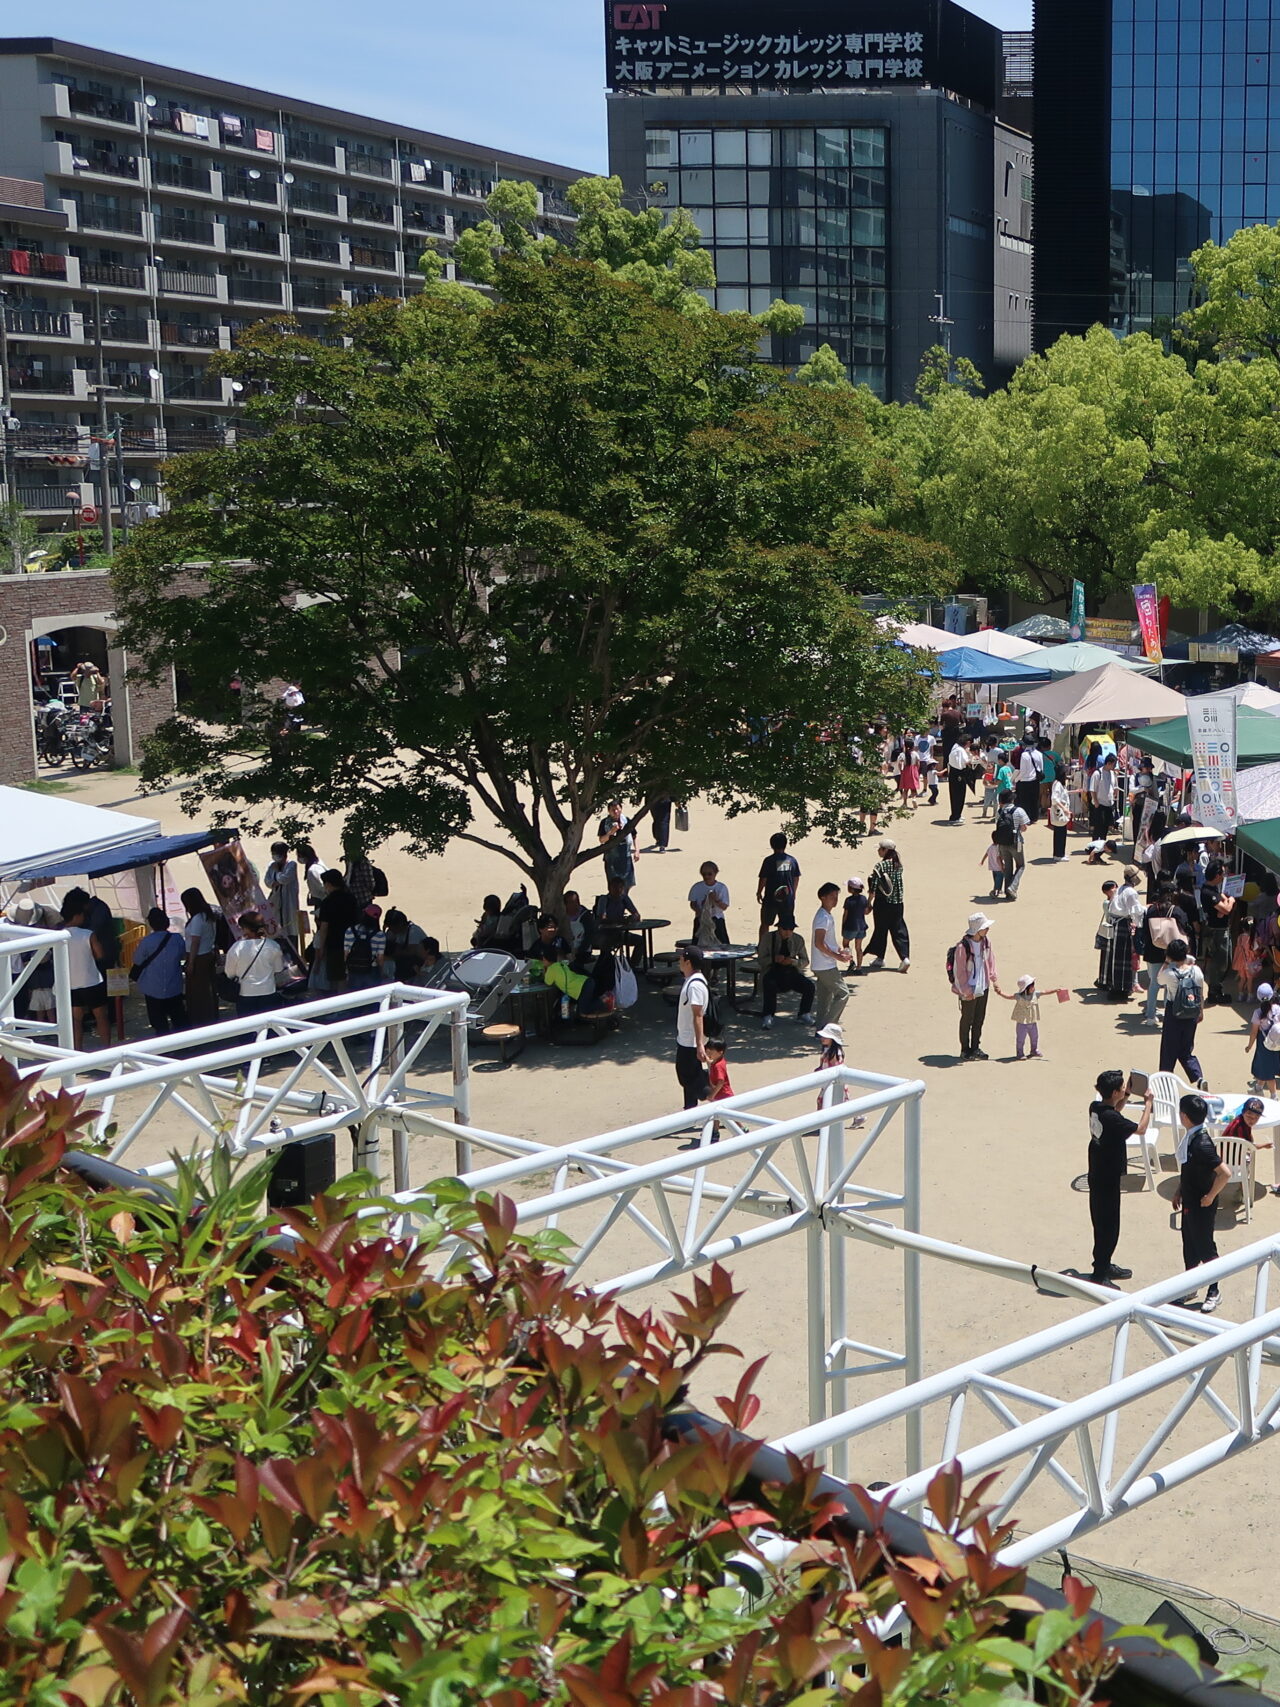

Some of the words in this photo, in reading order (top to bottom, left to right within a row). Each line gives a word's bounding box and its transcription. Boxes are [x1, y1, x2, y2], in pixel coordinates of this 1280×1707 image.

[614, 4, 667, 30] CAT
[615, 32, 924, 56] キャットミュージックカレッジ専門学校
